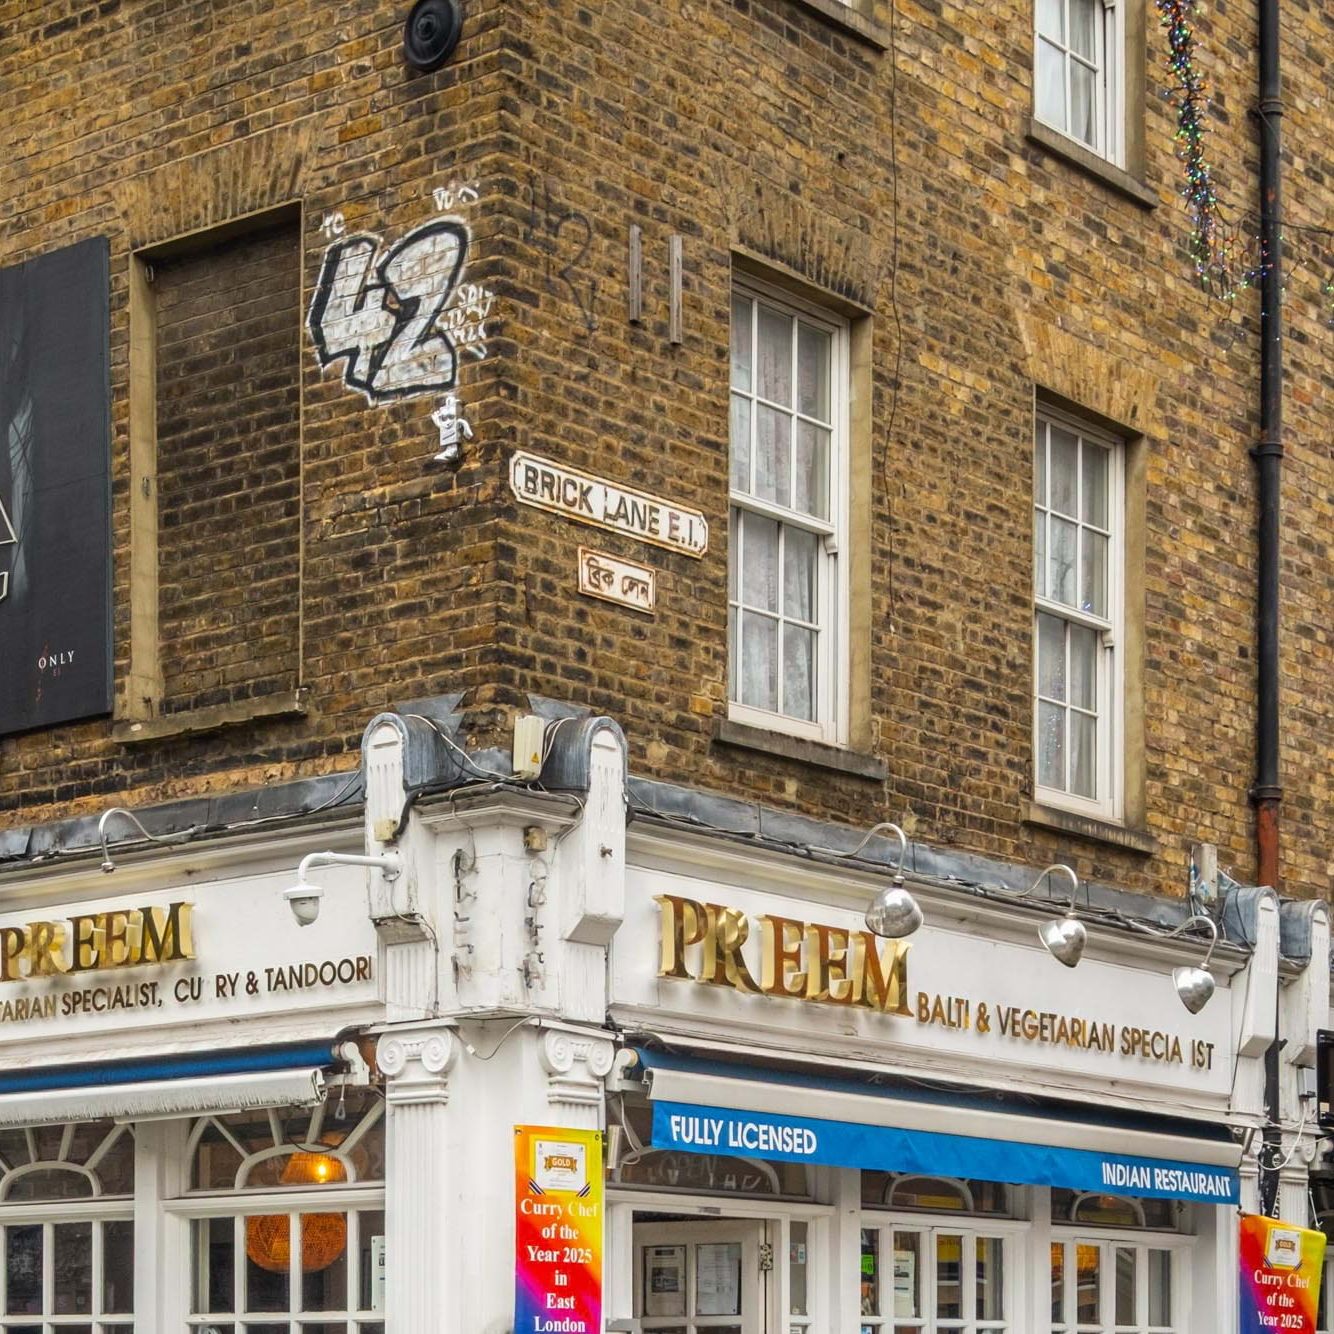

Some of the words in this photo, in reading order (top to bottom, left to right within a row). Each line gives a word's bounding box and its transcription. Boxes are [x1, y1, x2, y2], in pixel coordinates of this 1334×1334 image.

[524, 464, 593, 514] BRICK
[604, 487, 659, 535] LANE
[38, 650, 74, 669] ONLY
[652, 893, 915, 1018] PREEM
[246, 970, 259, 995] &
[265, 955, 373, 993] TANDOORI
[917, 991, 970, 1029] BALTI
[977, 1002, 991, 1033] &
[996, 1004, 1115, 1053] VEGETARIAN
[552, 1157, 571, 1168] GOLD
[670, 1115, 721, 1147] FULLY
[728, 1124, 817, 1155] LICENSED
[1102, 1162, 1151, 1189] INDIAN
[1155, 1168, 1231, 1197] RESTAURANT
[520, 1198, 564, 1219] Curry
[568, 1201, 599, 1217] Chef
[542, 1224, 558, 1239] of
[559, 1224, 578, 1240] the
[526, 1245, 560, 1263] Year
[562, 1247, 592, 1264] 2025
[555, 1270, 567, 1286] in
[1254, 1269, 1285, 1290] Curry
[1287, 1273, 1311, 1289] Chef
[546, 1292, 575, 1309] East
[1267, 1292, 1278, 1307] of
[1278, 1294, 1295, 1308] the
[534, 1316, 585, 1333] London
[1257, 1311, 1278, 1326] Year
[1280, 1313, 1303, 1329] 2025
